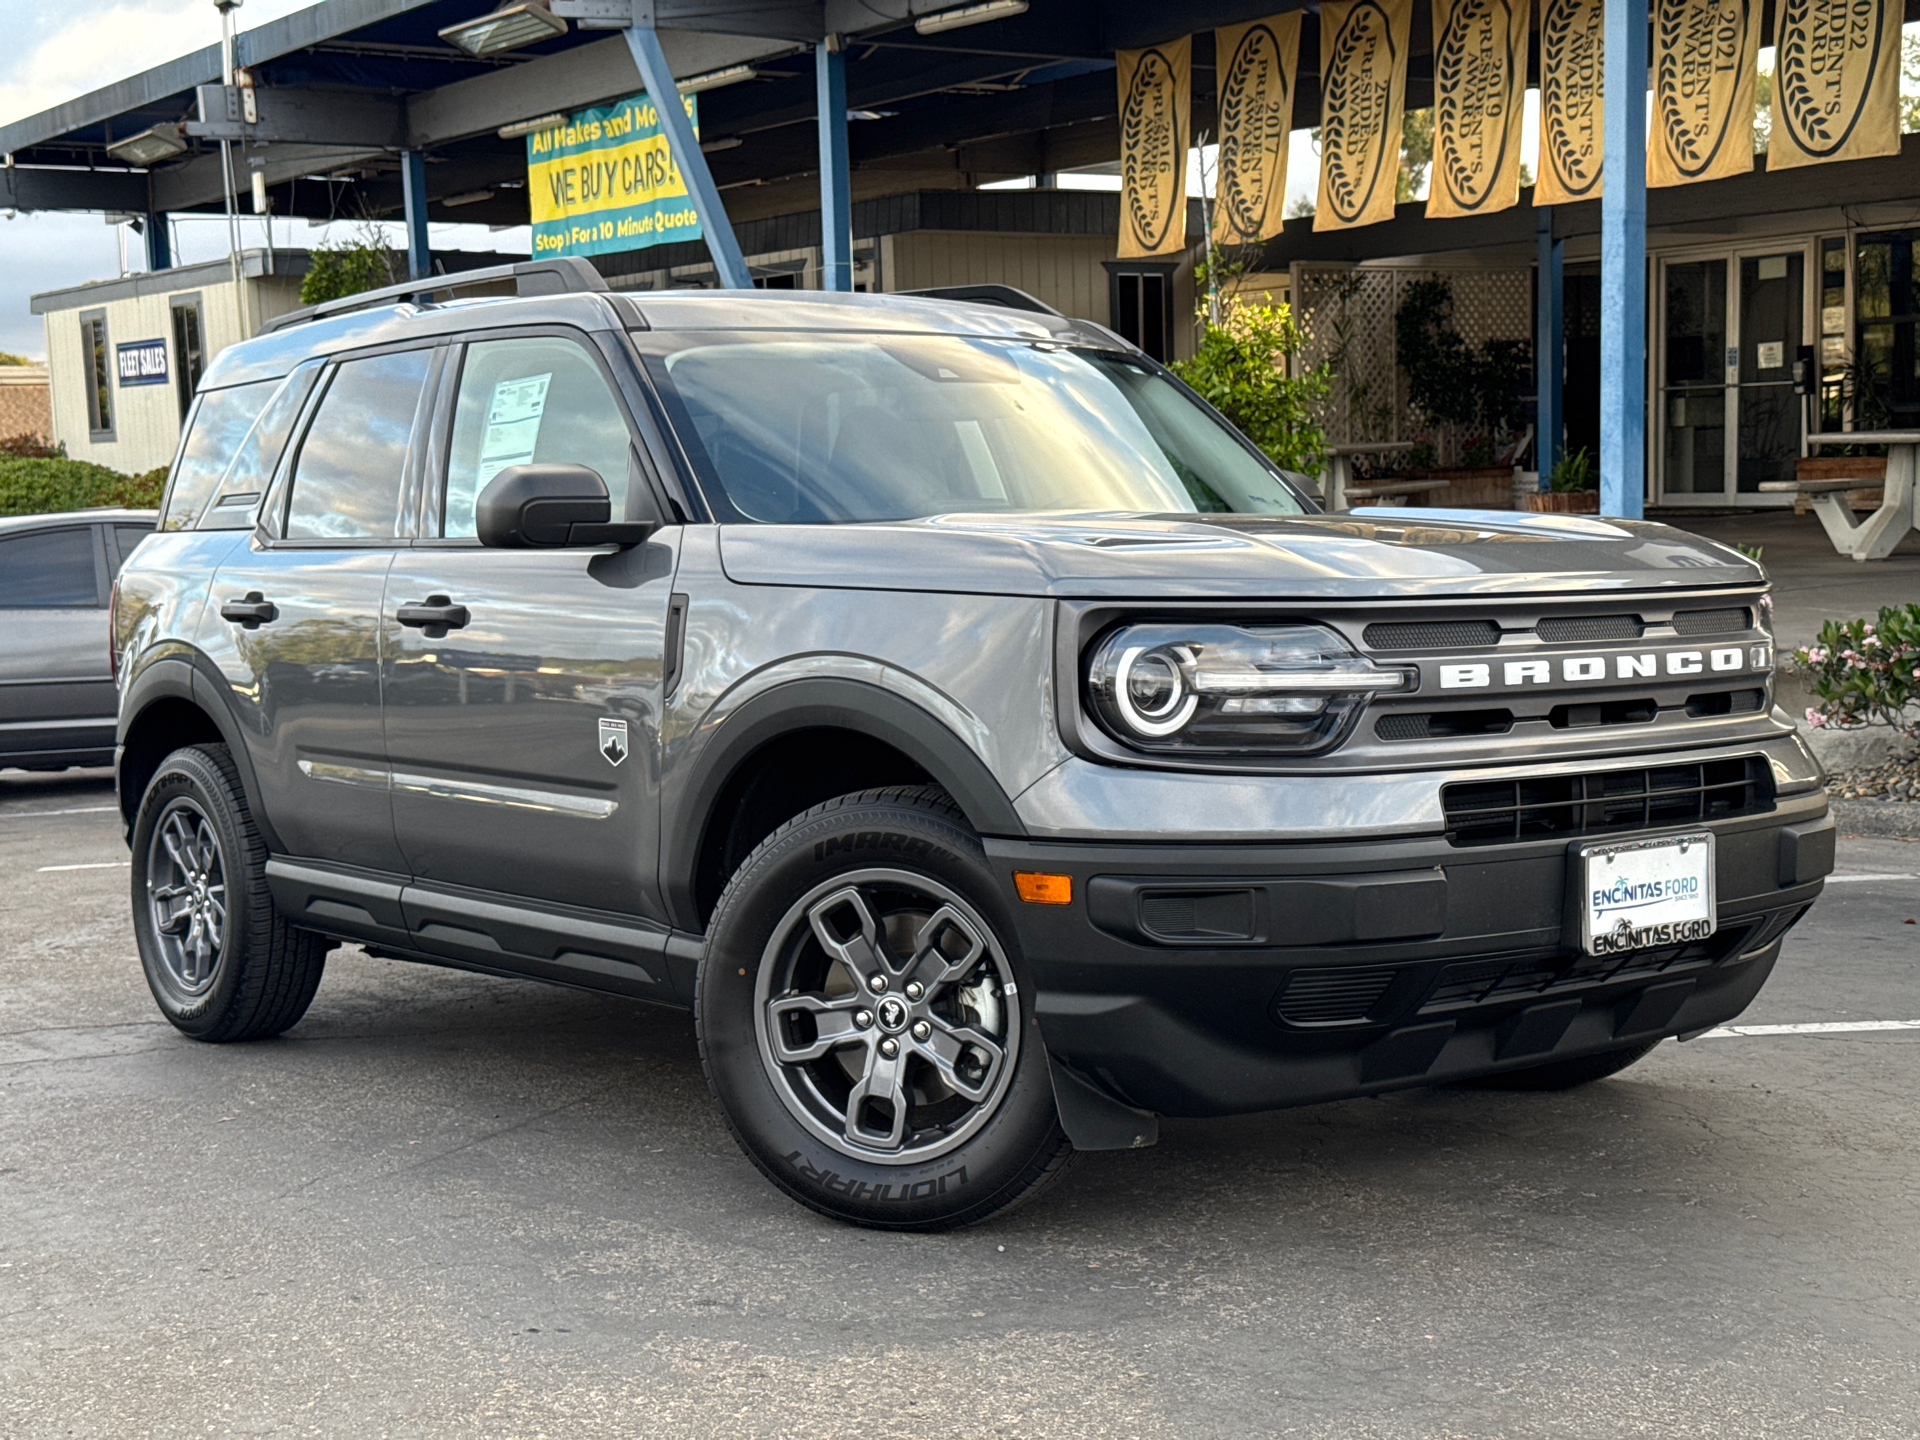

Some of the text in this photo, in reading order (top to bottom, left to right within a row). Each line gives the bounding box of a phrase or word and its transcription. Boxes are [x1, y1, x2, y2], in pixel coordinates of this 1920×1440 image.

[1681, 5, 1704, 99] AWARD
[1715, 10, 1735, 75] 2021
[1458, 52, 1479, 139] AWARD
[1470, 12, 1493, 175] PRESIDENT'S
[1486, 58, 1503, 118] 2019
[1565, 30, 1585, 121] AWARD
[532, 130, 552, 155] All
[554, 120, 601, 150] Makes
[602, 107, 632, 138] and
[1241, 94, 1256, 174] AWARD
[1251, 57, 1268, 206] PRESIDENT'S
[1265, 101, 1280, 154] 2017
[1346, 72, 1361, 156] AWARD
[1354, 34, 1377, 189] PRESIDENT'S
[549, 148, 676, 208] WE BUY CARS!
[1139, 115, 1155, 190] AWARD
[1148, 82, 1164, 221] PRESIDENT'S
[1158, 121, 1172, 174] 2016
[535, 233, 564, 252] Stop
[571, 227, 590, 244] For
[592, 227, 598, 241] a
[599, 220, 614, 240] 10
[617, 216, 654, 238] Minute
[655, 209, 698, 232] Quote
[119, 347, 166, 377] FLEET SALES
[1439, 648, 1742, 689] BRONCO
[1593, 876, 1698, 907] ENCINITAS FORD
[1593, 919, 1712, 955] ENCINITAS FORD
[779, 1150, 969, 1202] LIONHART
